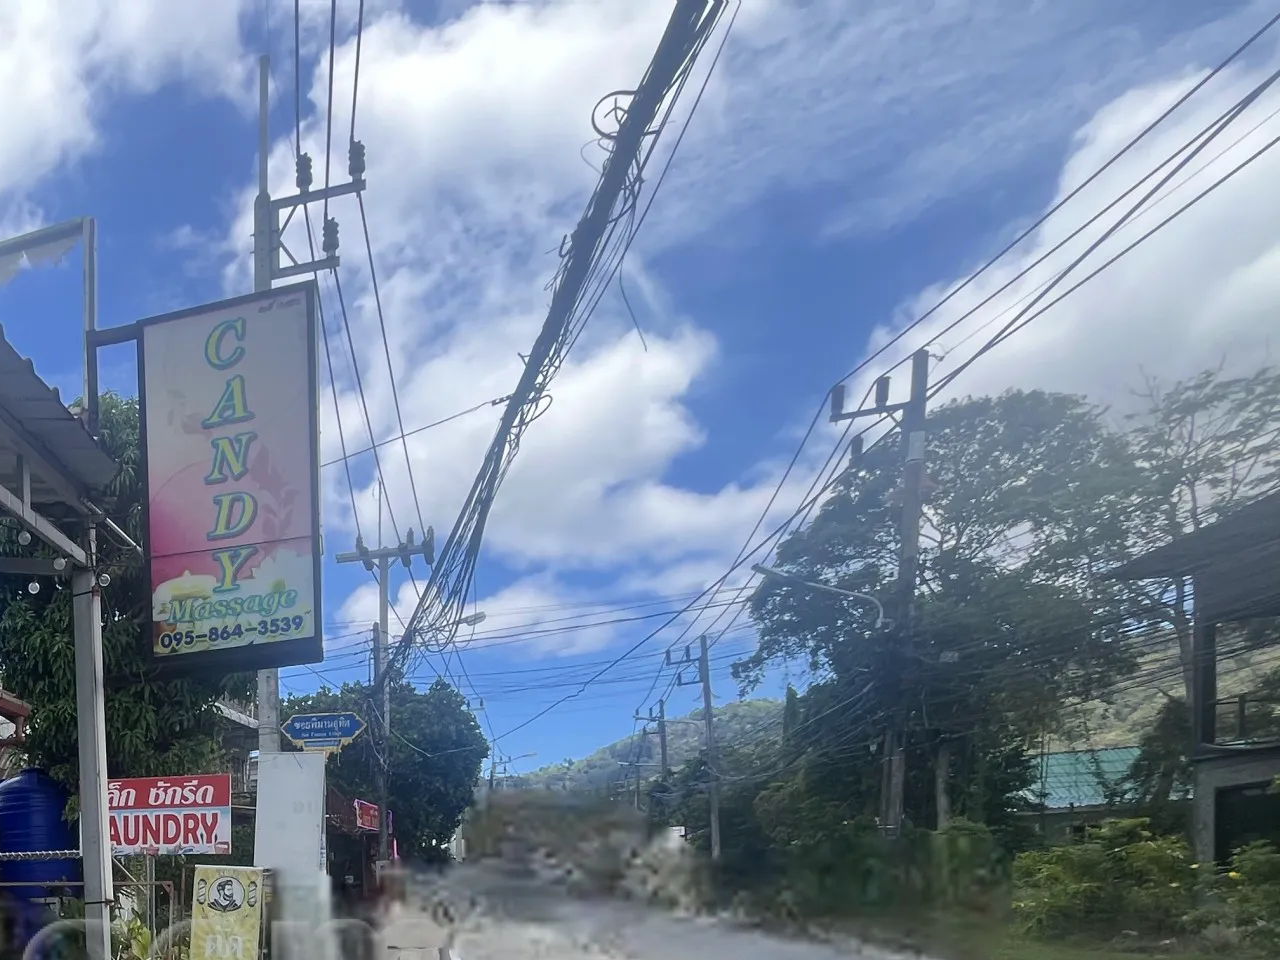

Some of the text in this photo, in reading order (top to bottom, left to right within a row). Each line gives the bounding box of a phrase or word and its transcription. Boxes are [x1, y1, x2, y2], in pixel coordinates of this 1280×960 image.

[202, 316, 258, 594] CANDY
[166, 588, 298, 625] Massage
[159, 614, 305, 649] 095-864-3539
[108, 780, 214, 807] ล็ก ซักรีด
[109, 811, 220, 847] AUNDRY
